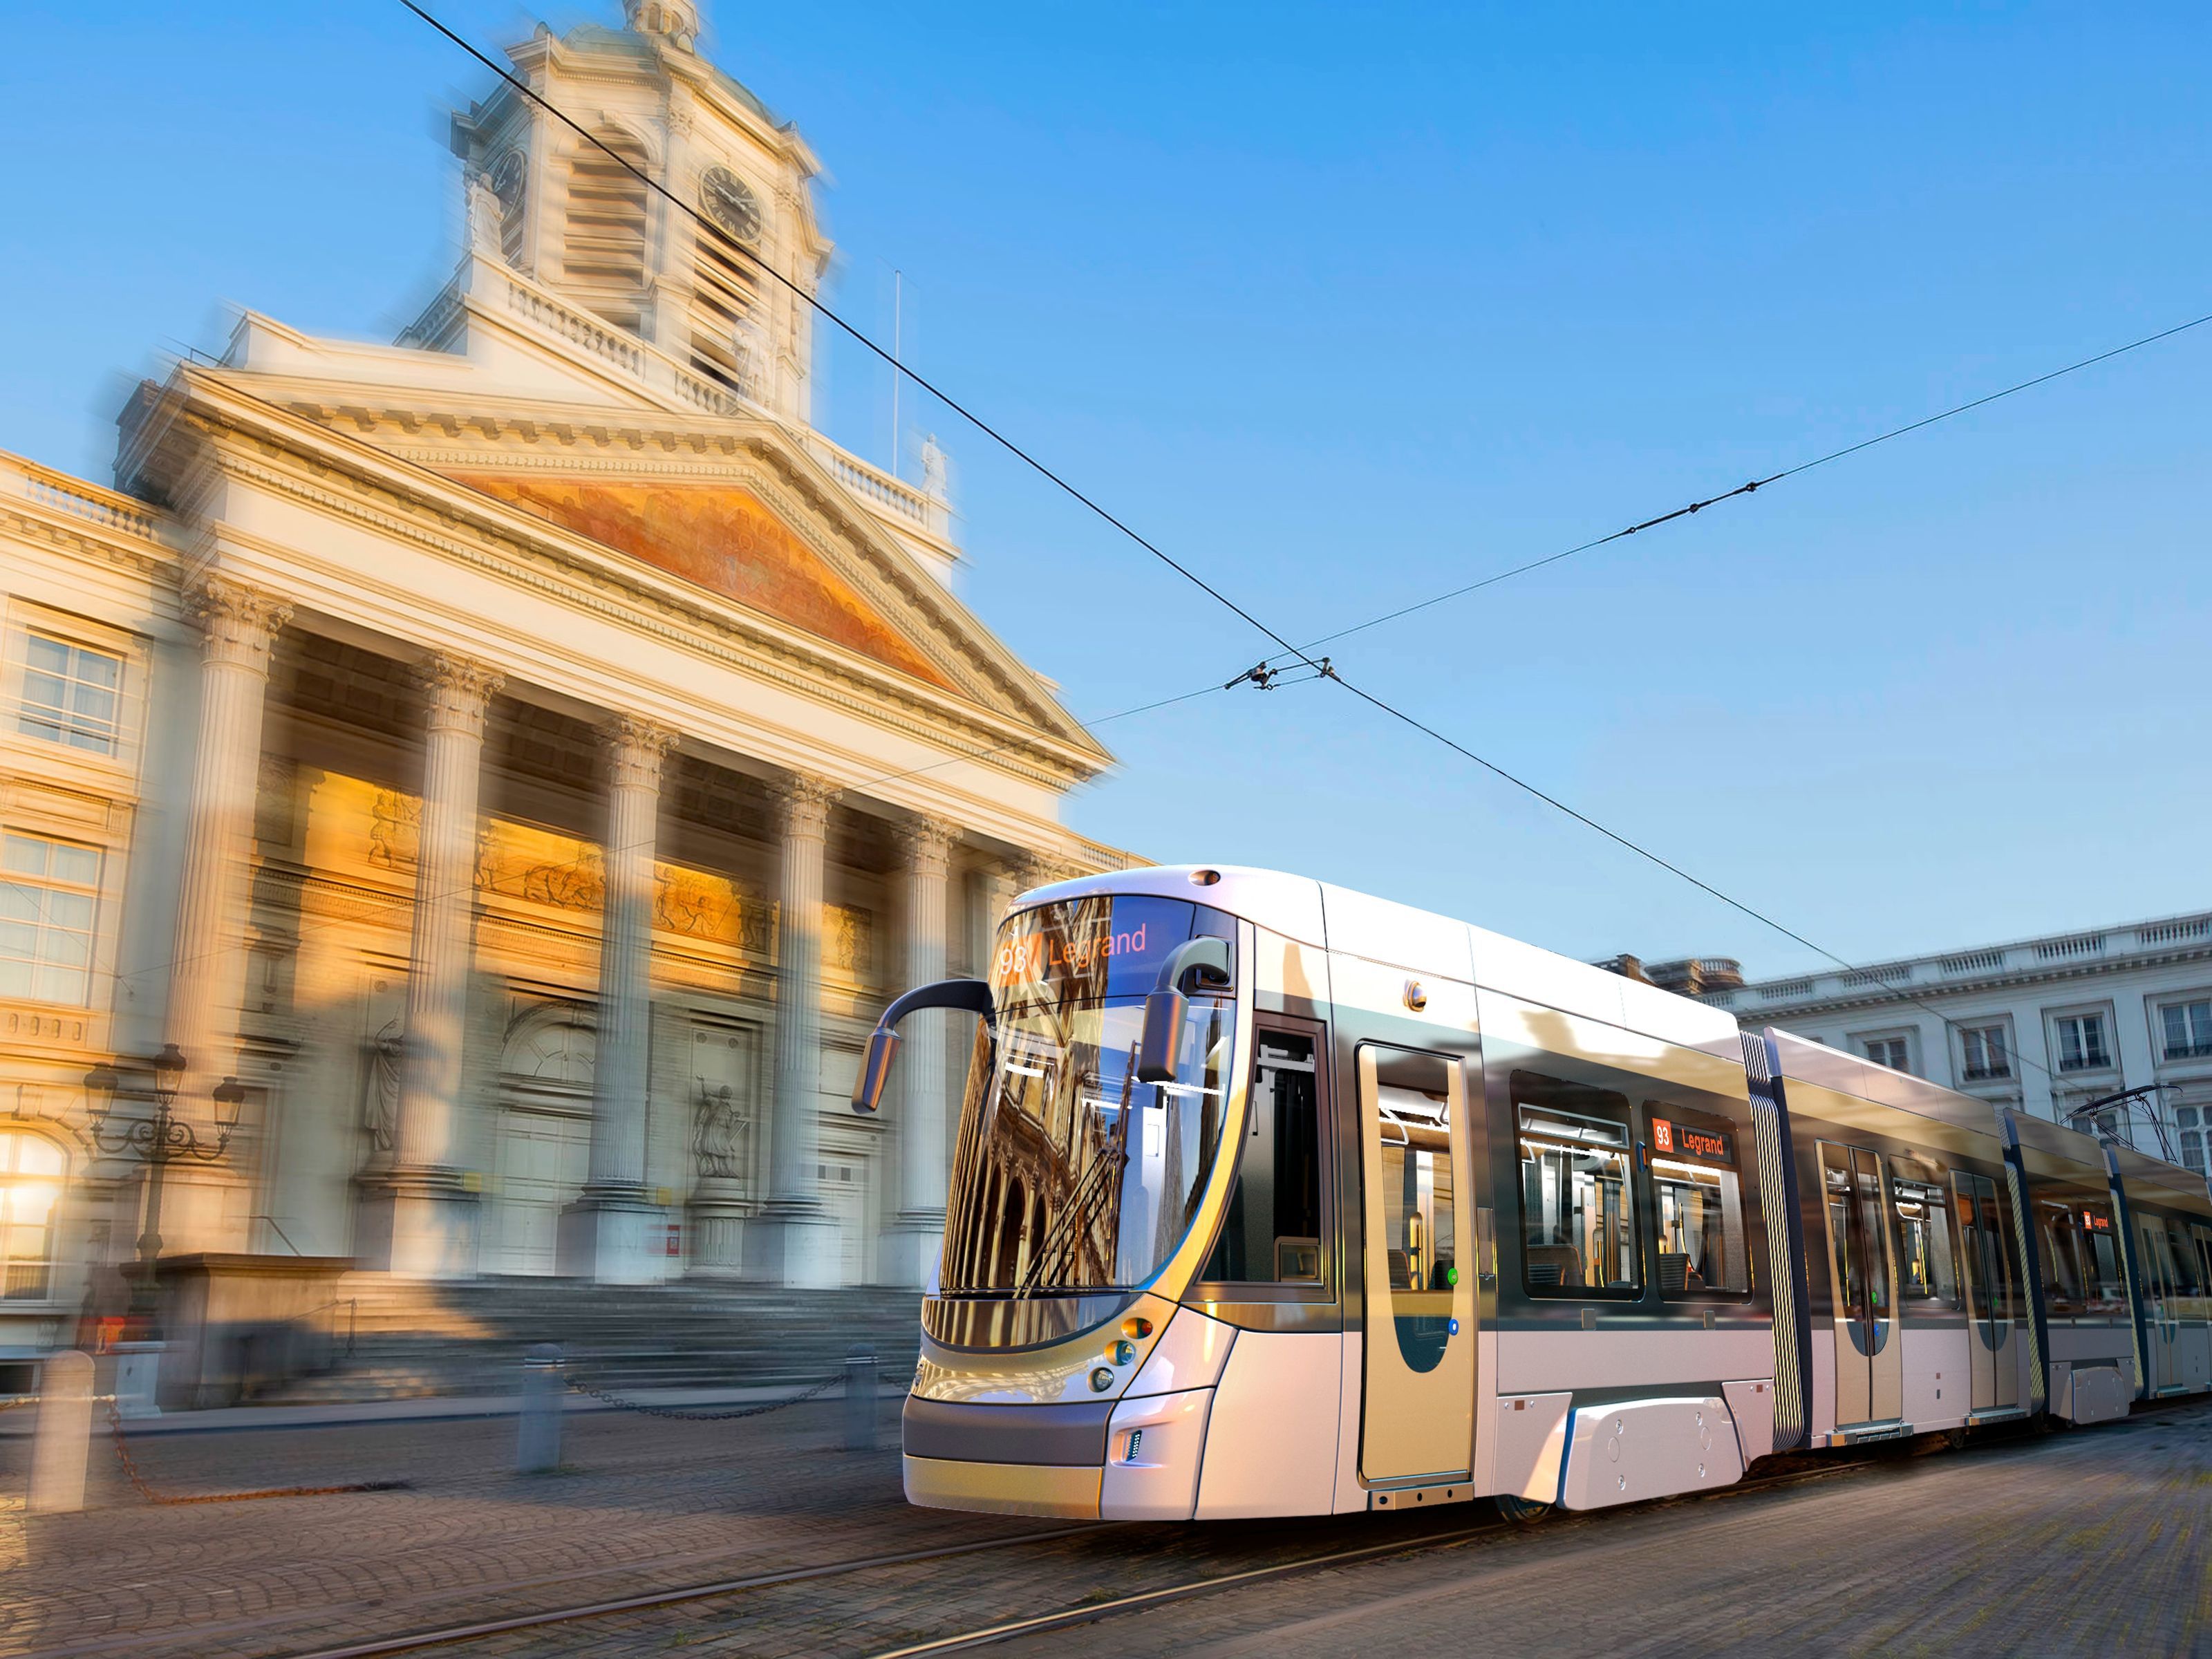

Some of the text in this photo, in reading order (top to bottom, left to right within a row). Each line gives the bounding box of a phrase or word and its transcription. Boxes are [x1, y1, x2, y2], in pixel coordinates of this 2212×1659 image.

[1000, 923, 1147, 975] 93 Legrand
[1656, 1125, 1724, 1156] 93 Legrand
[2093, 1215, 2108, 1229] Legrand
